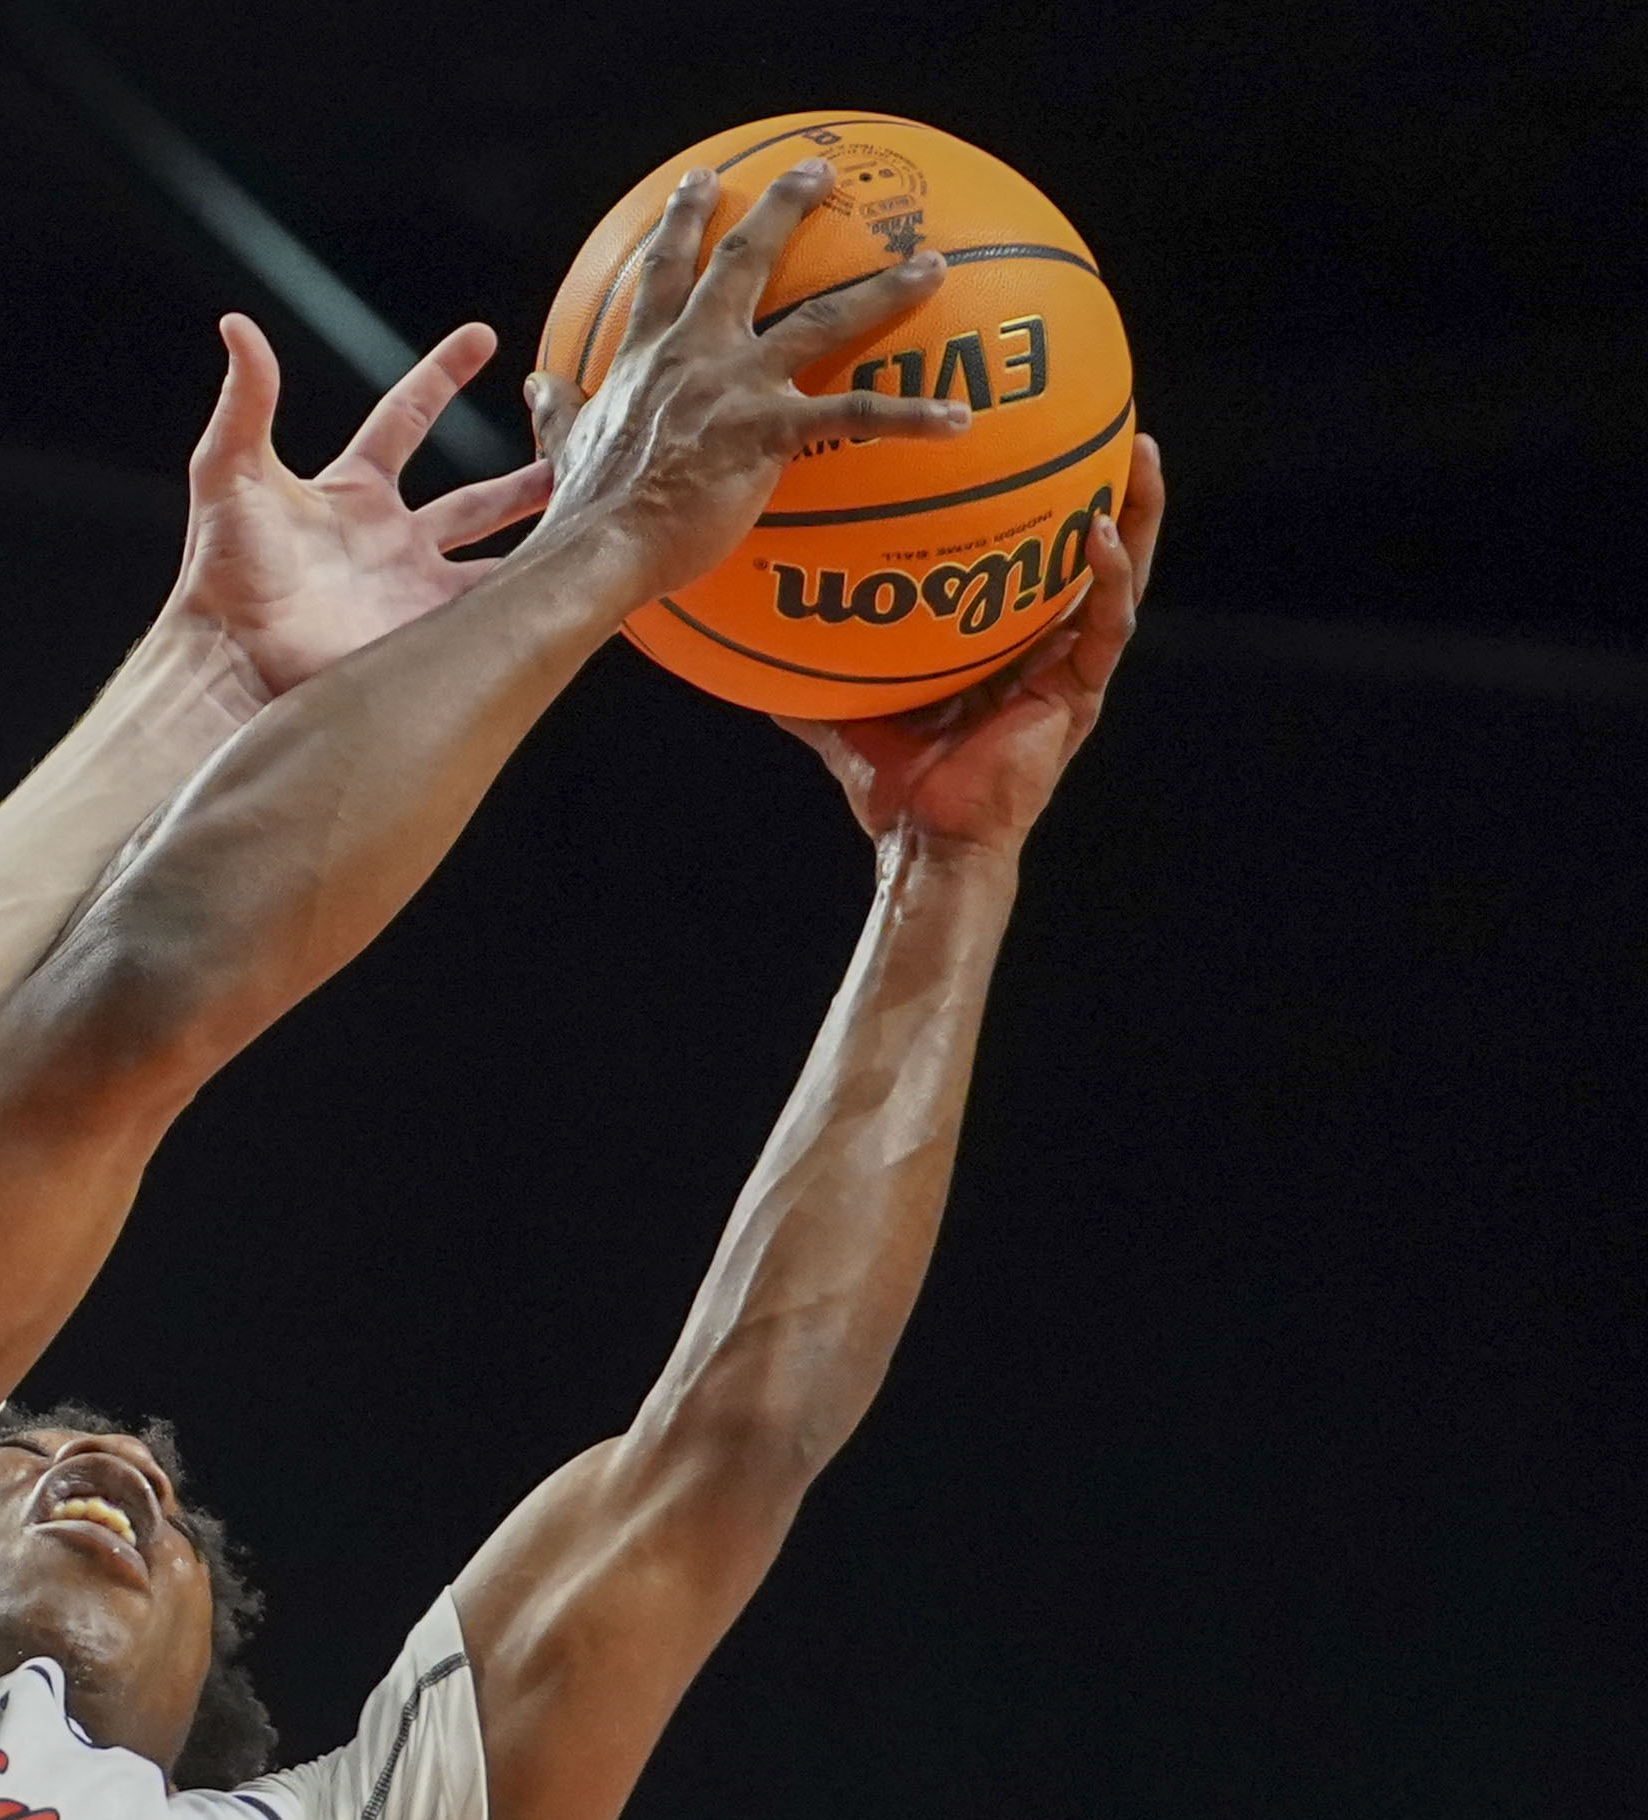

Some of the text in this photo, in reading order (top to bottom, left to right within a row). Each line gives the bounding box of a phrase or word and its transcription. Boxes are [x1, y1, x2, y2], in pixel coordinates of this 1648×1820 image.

[771, 484, 1112, 637] Wilson
[881, 510, 1054, 562] INDOOR GAME BALL
